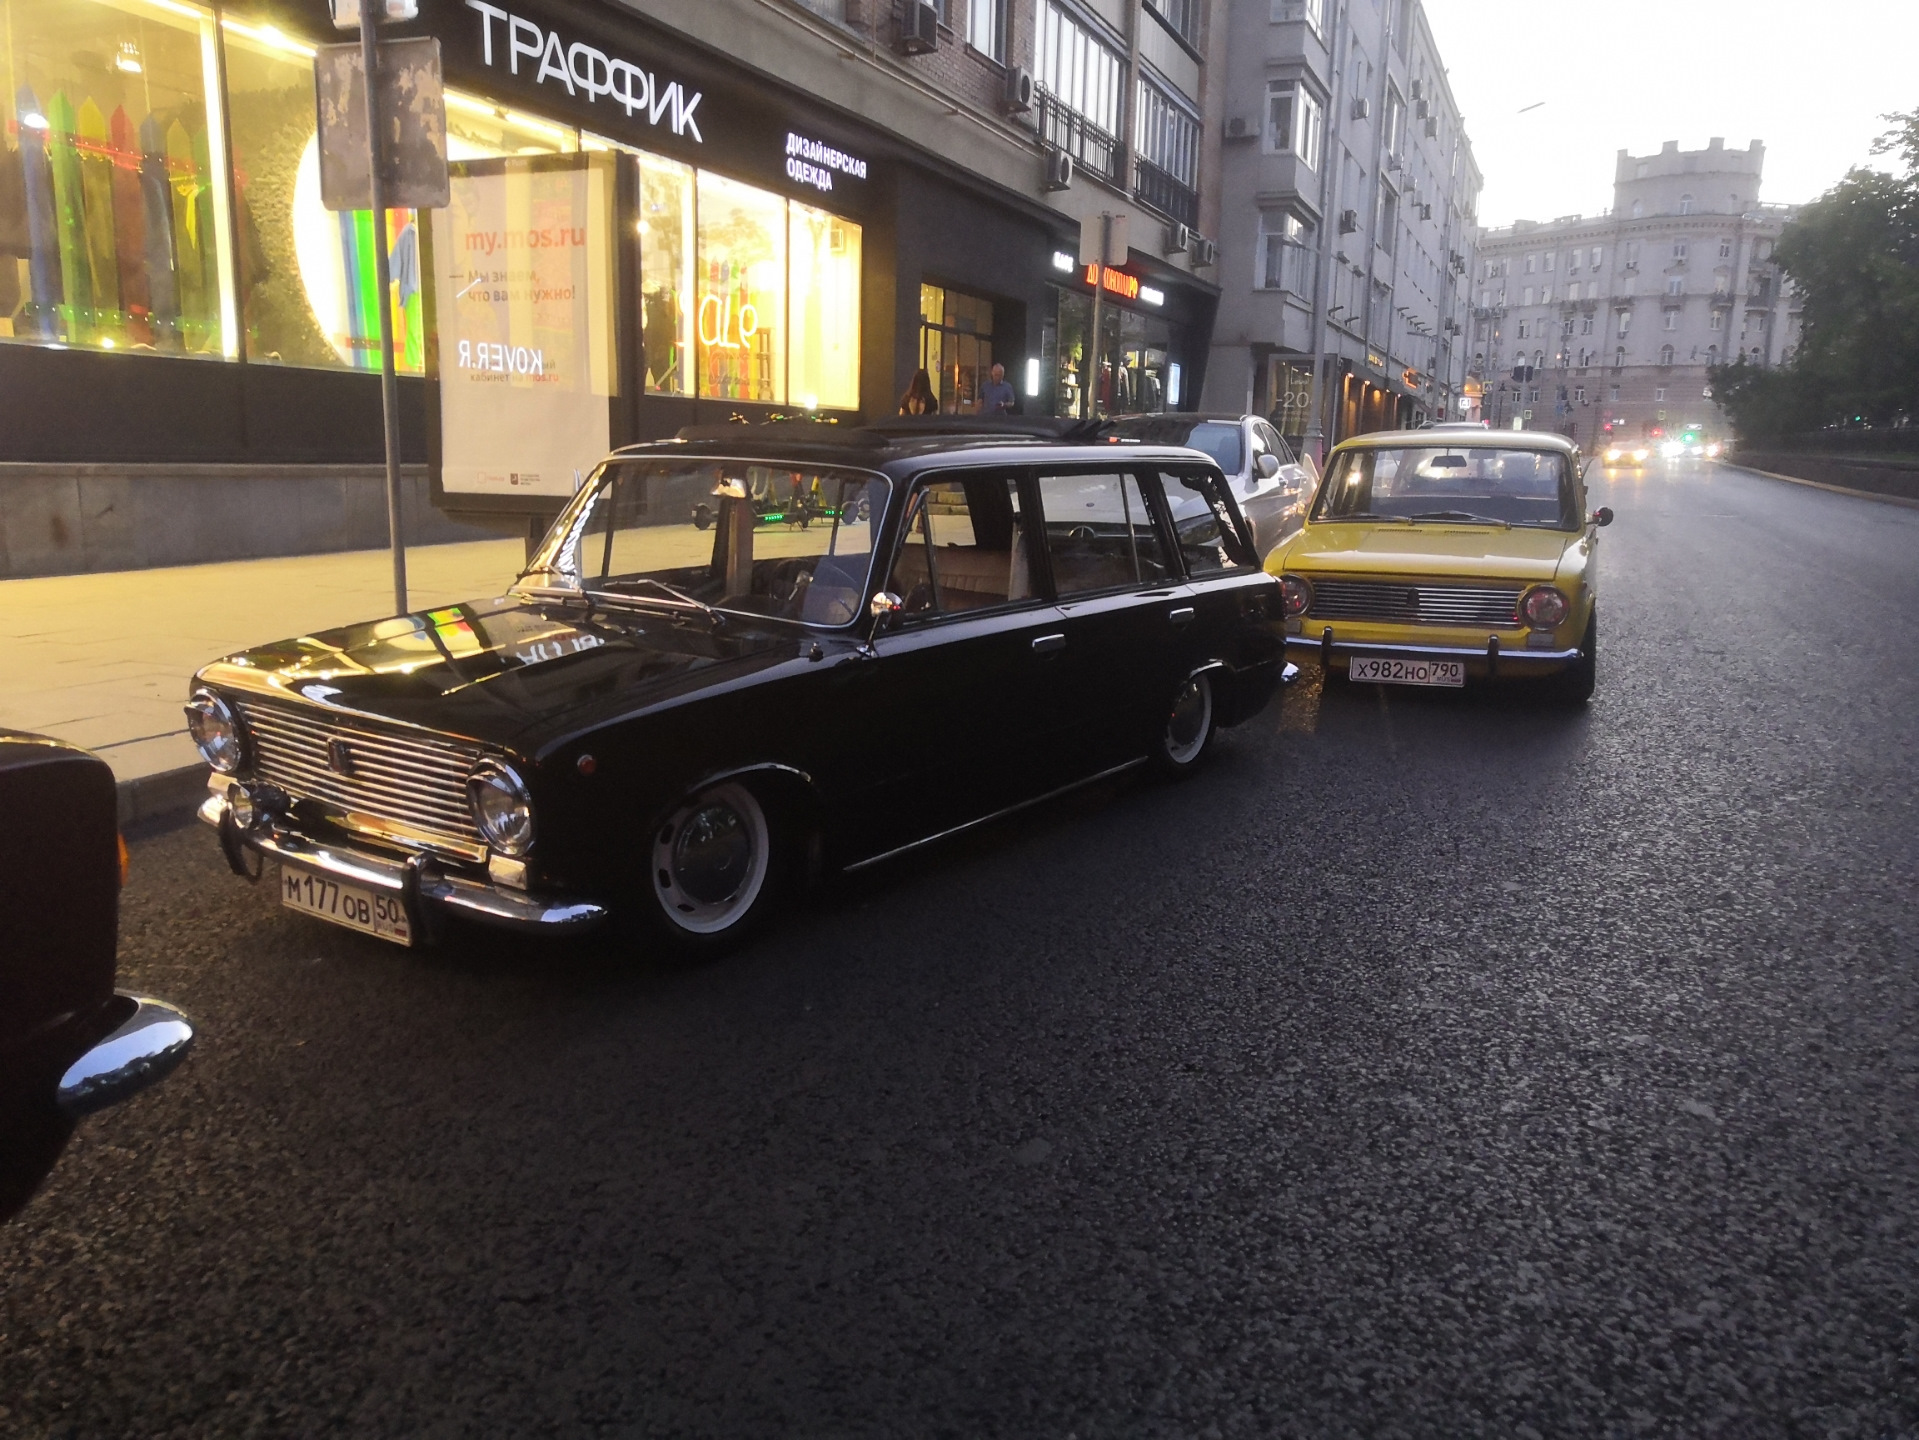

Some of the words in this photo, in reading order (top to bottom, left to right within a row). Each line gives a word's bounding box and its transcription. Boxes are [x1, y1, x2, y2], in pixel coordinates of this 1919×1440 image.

[464, 0, 703, 143] ТРАФФИК
[786, 132, 867, 179] ДИЗАЙНЕРСКАЯ
[786, 157, 833, 192] ОДЕЖДА
[465, 228, 585, 256] my.mos.ru
[468, 270, 489, 283] Мы
[468, 290, 490, 302] что
[524, 285, 576, 304] нужно!
[1431, 663, 1459, 677] 790
[375, 894, 399, 923] 50
